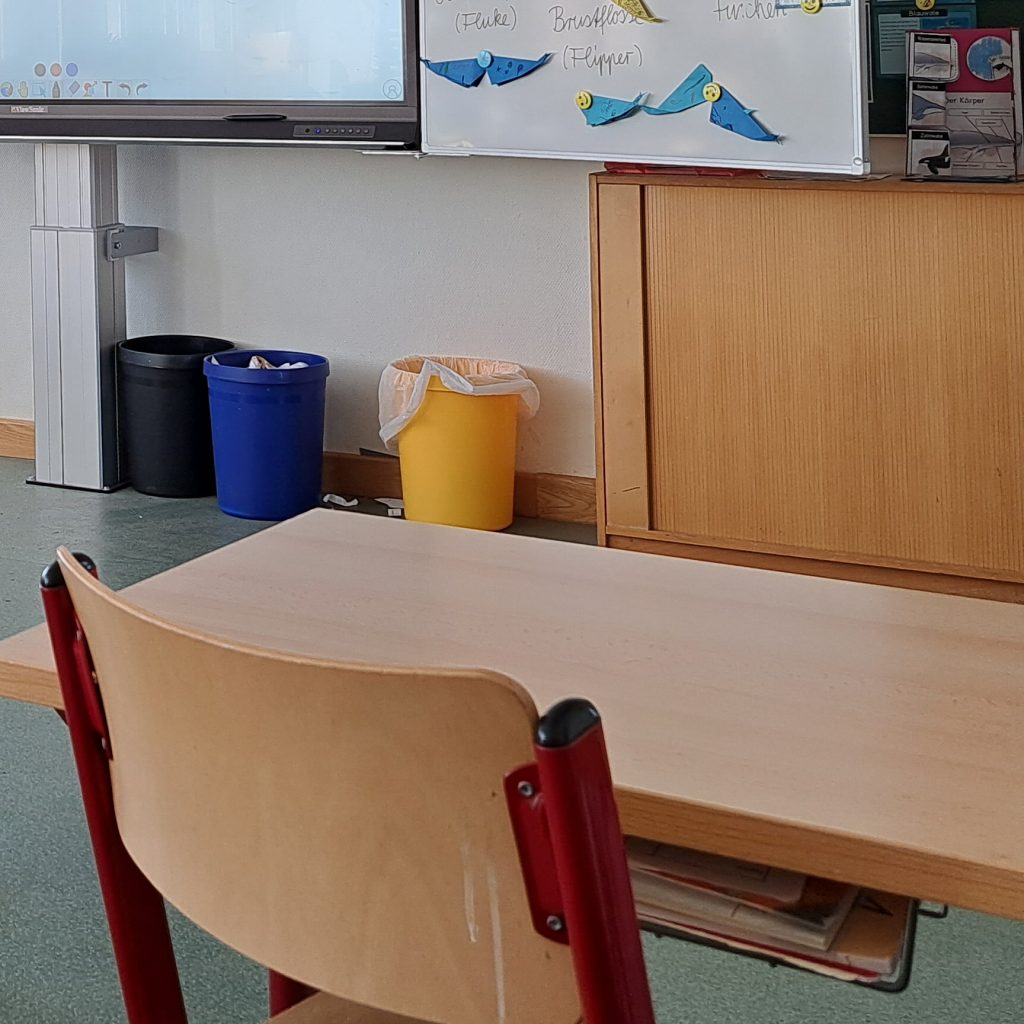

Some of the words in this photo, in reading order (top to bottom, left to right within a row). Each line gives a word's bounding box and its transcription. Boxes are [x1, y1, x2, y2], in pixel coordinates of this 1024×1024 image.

[455, 5, 517, 34] (Fluke)
[563, 44, 643, 77] (Flipper)
[959, 96, 985, 105] Körper
